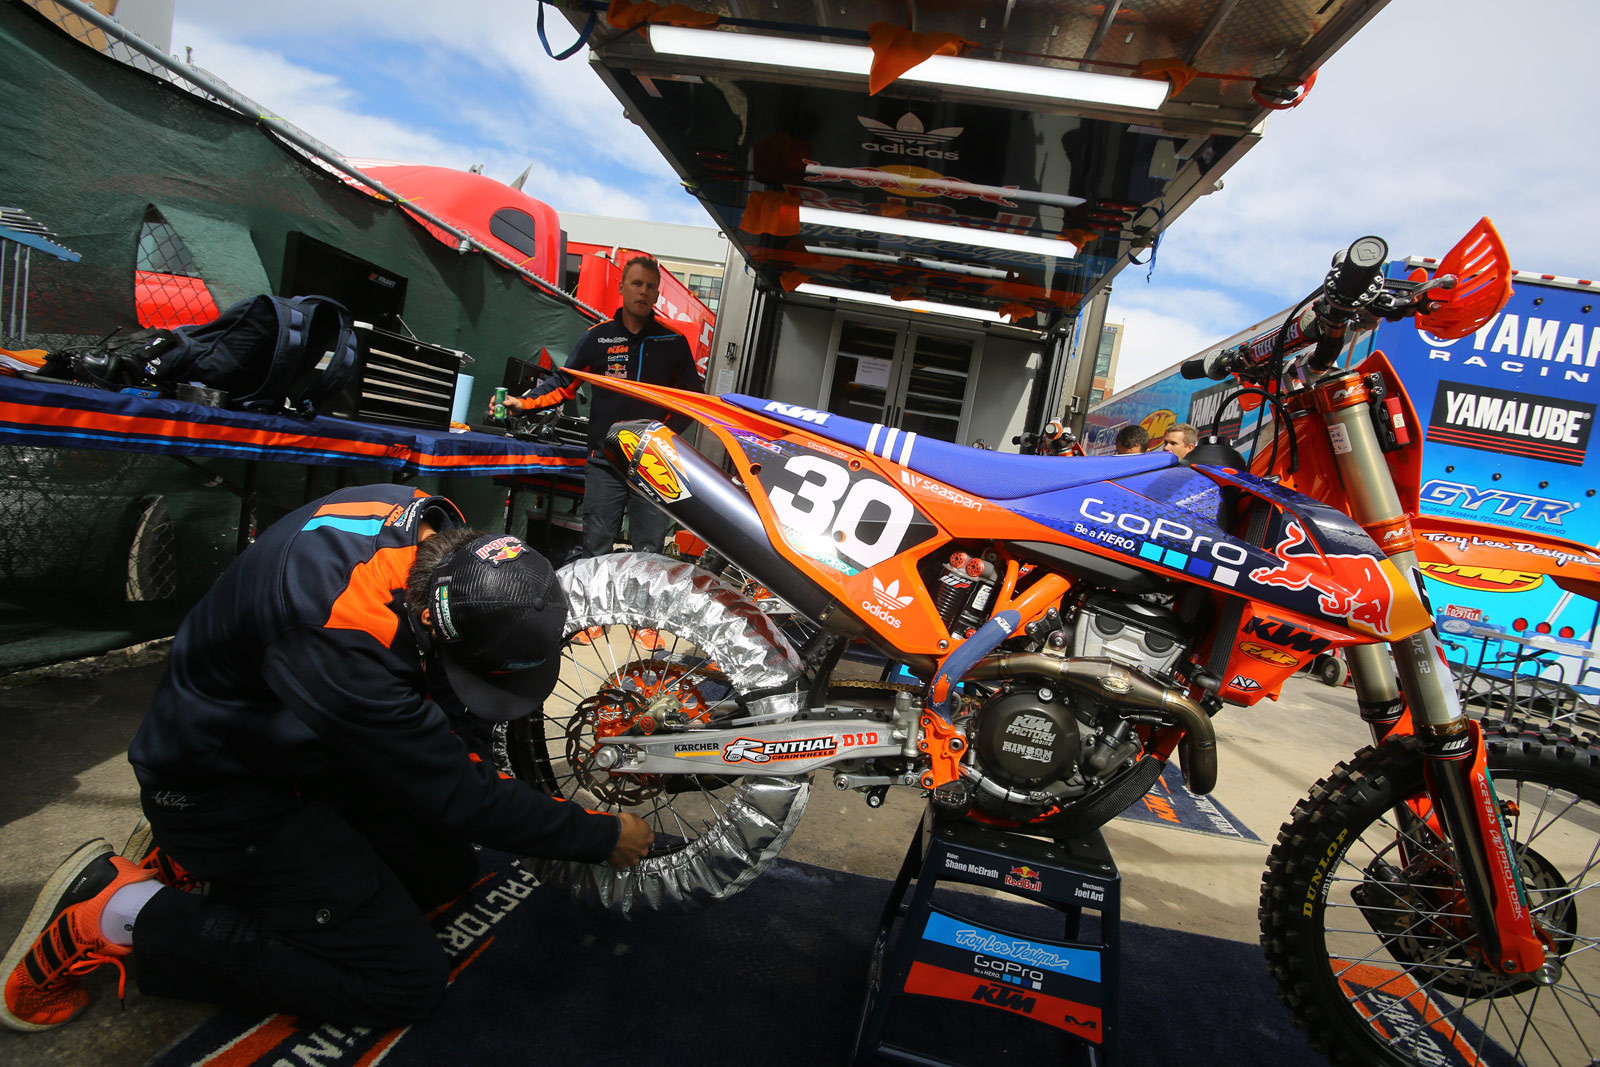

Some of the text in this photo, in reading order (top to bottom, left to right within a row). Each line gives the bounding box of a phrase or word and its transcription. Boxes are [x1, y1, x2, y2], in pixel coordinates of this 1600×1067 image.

[861, 140, 960, 161] adidas
[764, 401, 830, 425] KTM
[1446, 391, 1584, 444] YAMALUBE
[652, 437, 678, 461] KTM
[921, 479, 983, 512] seaspan
[1420, 480, 1575, 526] GYTR
[768, 455, 914, 568] 30
[1446, 509, 1478, 520] YAMAHA
[1480, 515, 1533, 531] TECHNOLOGY
[1534, 525, 1566, 535] RACING
[1074, 523, 1088, 535] Be
[1096, 530, 1136, 552] HERO.
[1079, 497, 1248, 566] GoPro
[1421, 533, 1600, 567] Troy Lee Designs
[861, 600, 902, 629] adidas
[994, 616, 1012, 634] KTM
[1241, 615, 1332, 654] KTM
[1241, 644, 1297, 665] FMF
[1005, 724, 1056, 742] FACTORY
[1011, 714, 1053, 732] KTM
[674, 743, 719, 752] KÄRCHER
[842, 732, 878, 747] DID
[1003, 740, 1054, 757] HINSON
[771, 750, 834, 760] CHAINWHEELS
[945, 859, 999, 879] Shane McElrath
[1303, 828, 1348, 918] DUNLOP
[1005, 875, 1042, 892] Red Bull
[1074, 887, 1104, 902] Joel Ard
[1500, 850, 1524, 920] PRO TORK
[956, 930, 1070, 967] Troy Lee Designs
[974, 954, 1044, 981] GoPro
[972, 983, 1036, 1014] KTM
